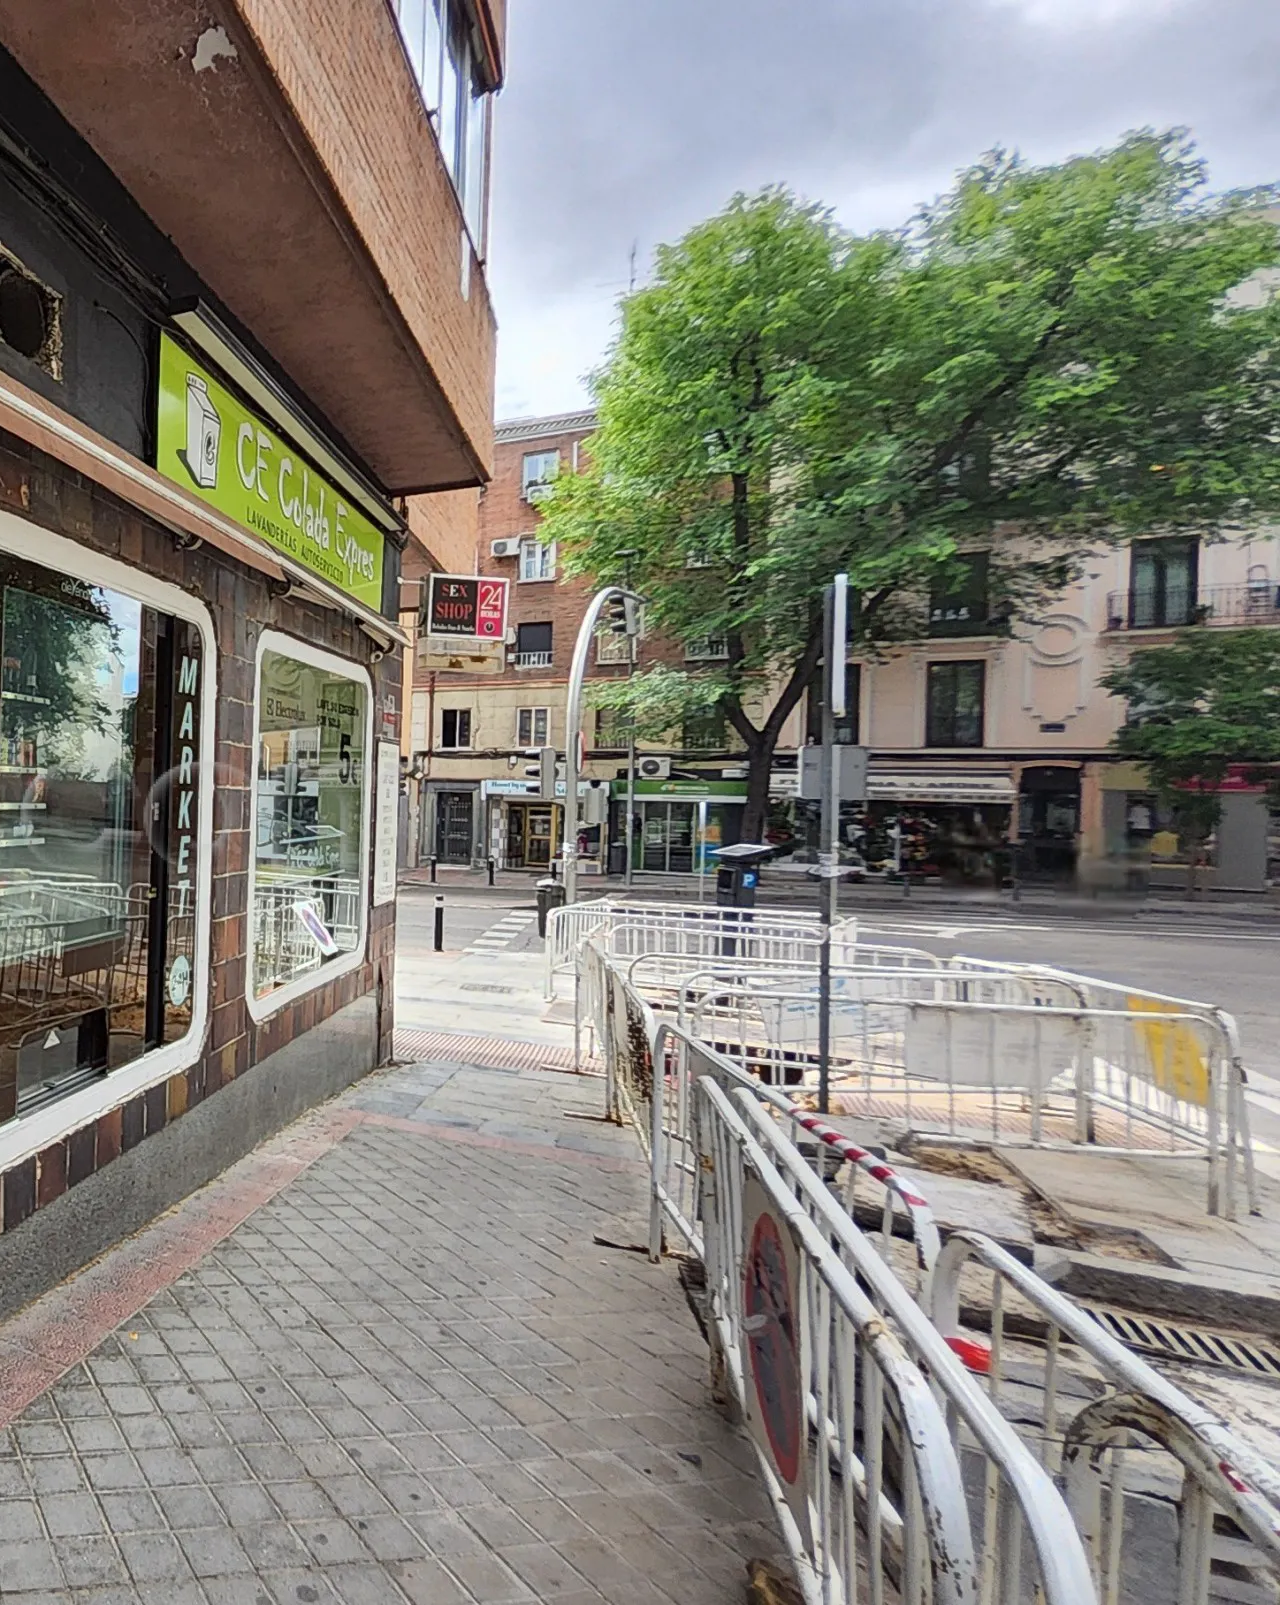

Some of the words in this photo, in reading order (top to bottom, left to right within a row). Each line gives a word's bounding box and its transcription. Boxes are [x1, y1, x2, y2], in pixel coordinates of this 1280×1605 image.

[236, 422, 273, 503] CE
[278, 457, 329, 551] Colada
[336, 501, 374, 586] Expres
[246, 505, 297, 553] LAVANDERÍAS
[301, 544, 344, 584] AUTOSERVICIO
[441, 583, 468, 597] SEX
[481, 585, 502, 610] 24
[435, 601, 473, 619] SHOP
[177, 655, 198, 918] MARKET
[743, 874, 755, 887] P
